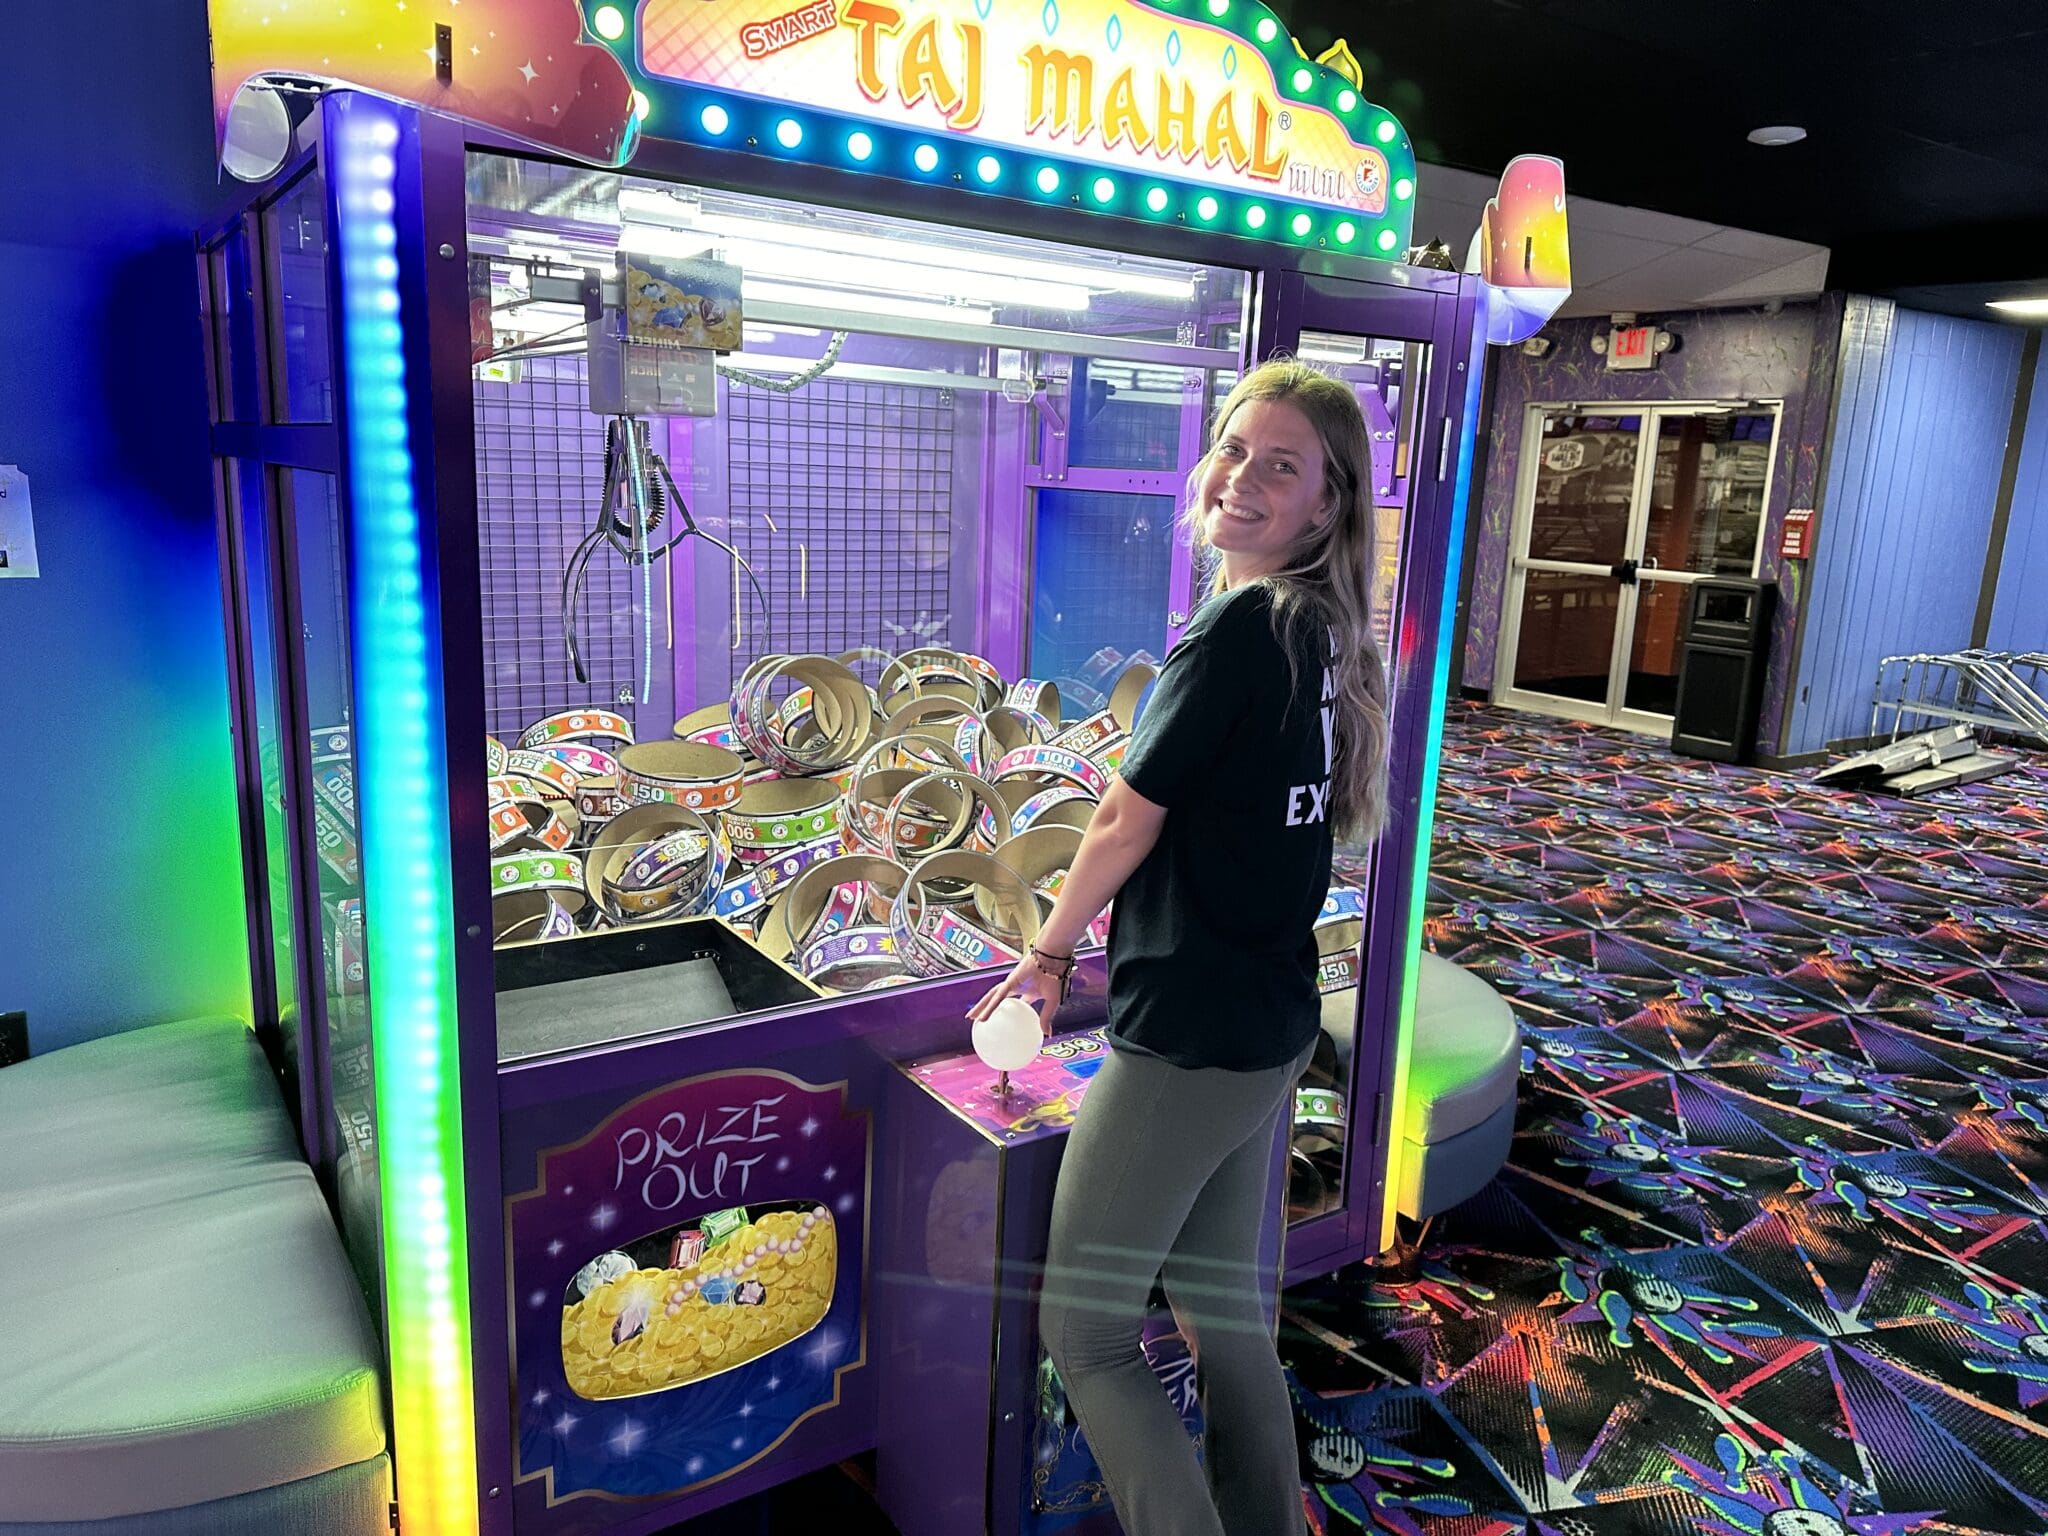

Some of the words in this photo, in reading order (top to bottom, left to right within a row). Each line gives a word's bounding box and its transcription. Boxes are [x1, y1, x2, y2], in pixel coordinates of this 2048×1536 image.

[740, 0, 837, 60] SMART
[840, 0, 984, 132] TAJ
[1019, 43, 1288, 183] MAHAL
[1615, 327, 1648, 356] EXIT
[1042, 751, 1076, 768] 100
[631, 783, 665, 802] 150
[1286, 780, 1331, 827] EX
[726, 823, 755, 841] 900
[950, 928, 985, 957] 100
[1319, 961, 1349, 980] 150
[614, 1092, 788, 1192] PRIZE
[641, 1151, 767, 1211] OUT
